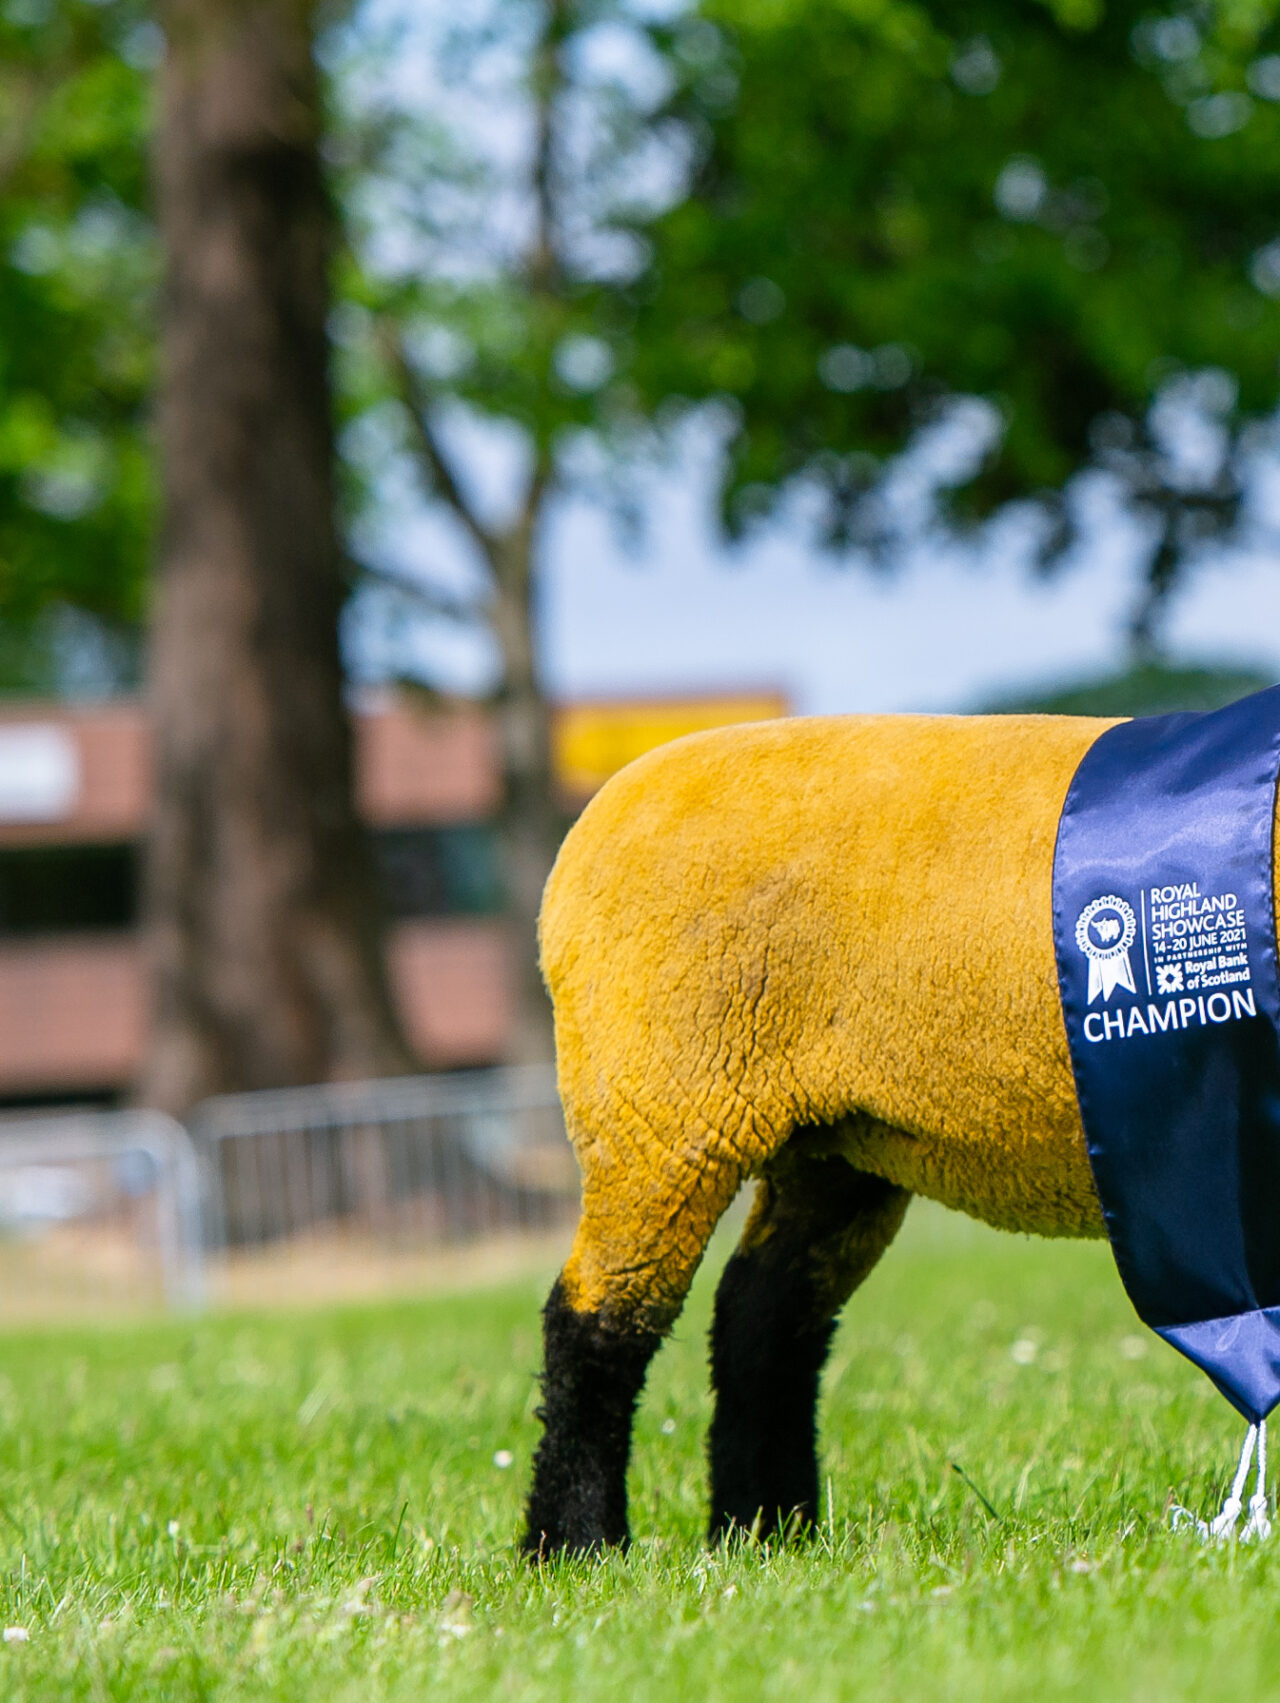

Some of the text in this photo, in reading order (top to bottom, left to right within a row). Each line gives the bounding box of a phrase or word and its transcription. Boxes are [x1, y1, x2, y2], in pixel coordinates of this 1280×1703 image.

[1151, 882, 1201, 904] ROYAL
[1151, 894, 1237, 922] HIGHLAND
[1152, 910, 1245, 940] SHOWCASE
[1153, 928, 1246, 954] 14-20 JUNE 2021
[1167, 947, 1222, 961] PARTNERSHIP
[1225, 943, 1247, 951] WITH
[1185, 953, 1248, 976] Royal Bank
[1187, 967, 1250, 989] of Scotland
[1083, 988, 1256, 1042] CHAMPION
